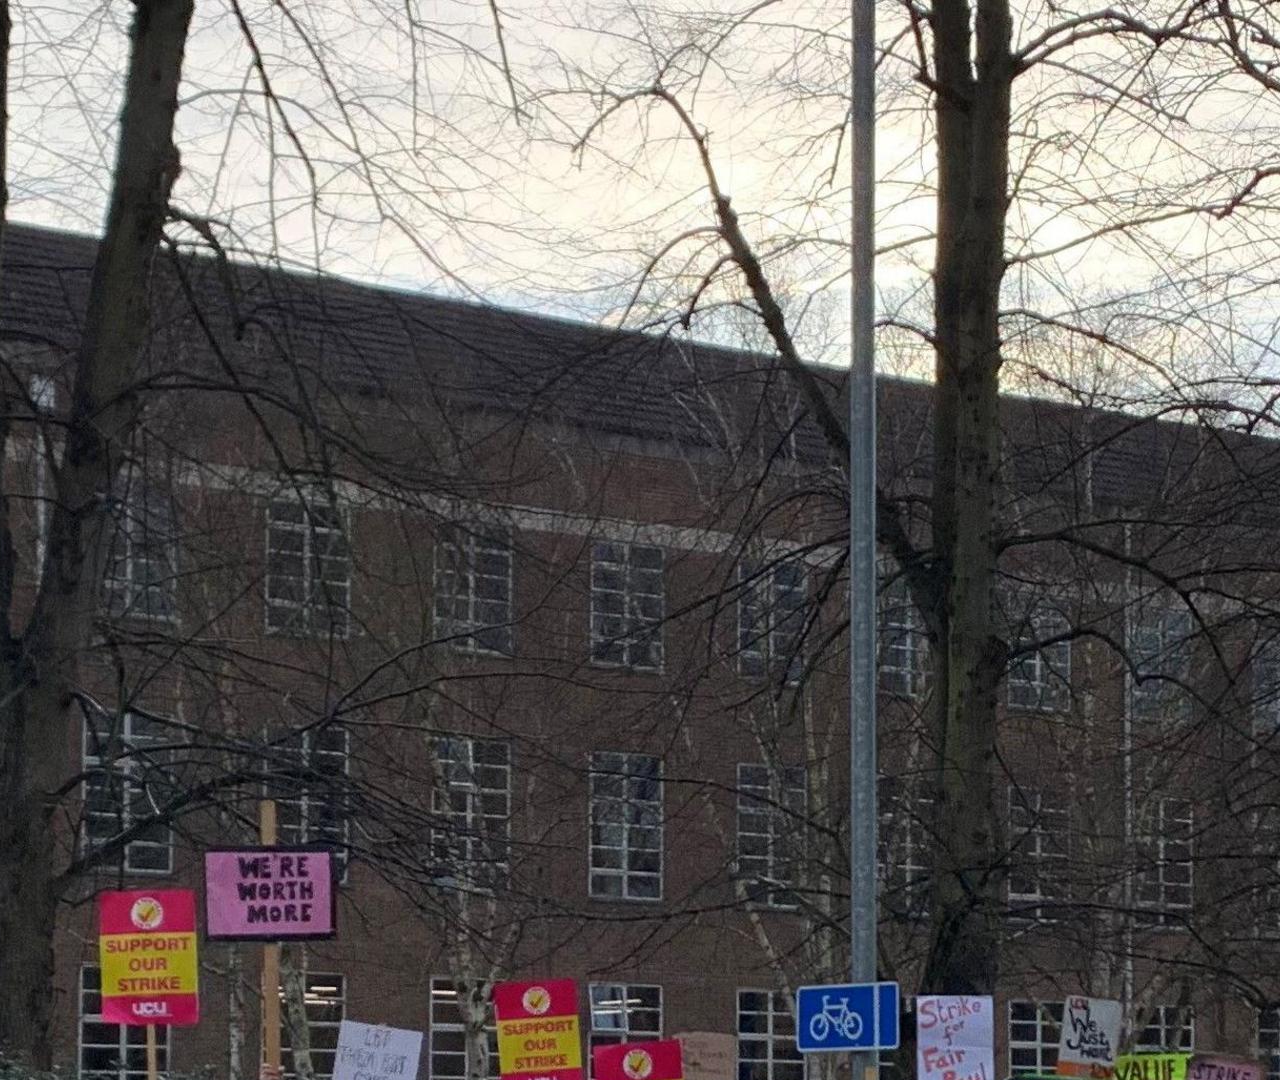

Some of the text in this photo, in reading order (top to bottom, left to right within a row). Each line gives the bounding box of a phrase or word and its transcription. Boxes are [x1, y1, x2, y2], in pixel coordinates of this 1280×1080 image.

[238, 856, 309, 879] WE'RE
[237, 882, 313, 901] WORTH
[247, 904, 312, 923] MORE
[106, 937, 190, 954] SUPPORT
[128, 958, 167, 972] OUR
[118, 976, 181, 993] STRIKE
[920, 997, 981, 1029] Strike
[1069, 1008, 1096, 1033] We
[503, 1020, 574, 1036] SUPPORT
[943, 1020, 964, 1046] for
[524, 1040, 557, 1050] OUR
[514, 1054, 568, 1069] STRIKE
[923, 1046, 965, 1073] Fair
